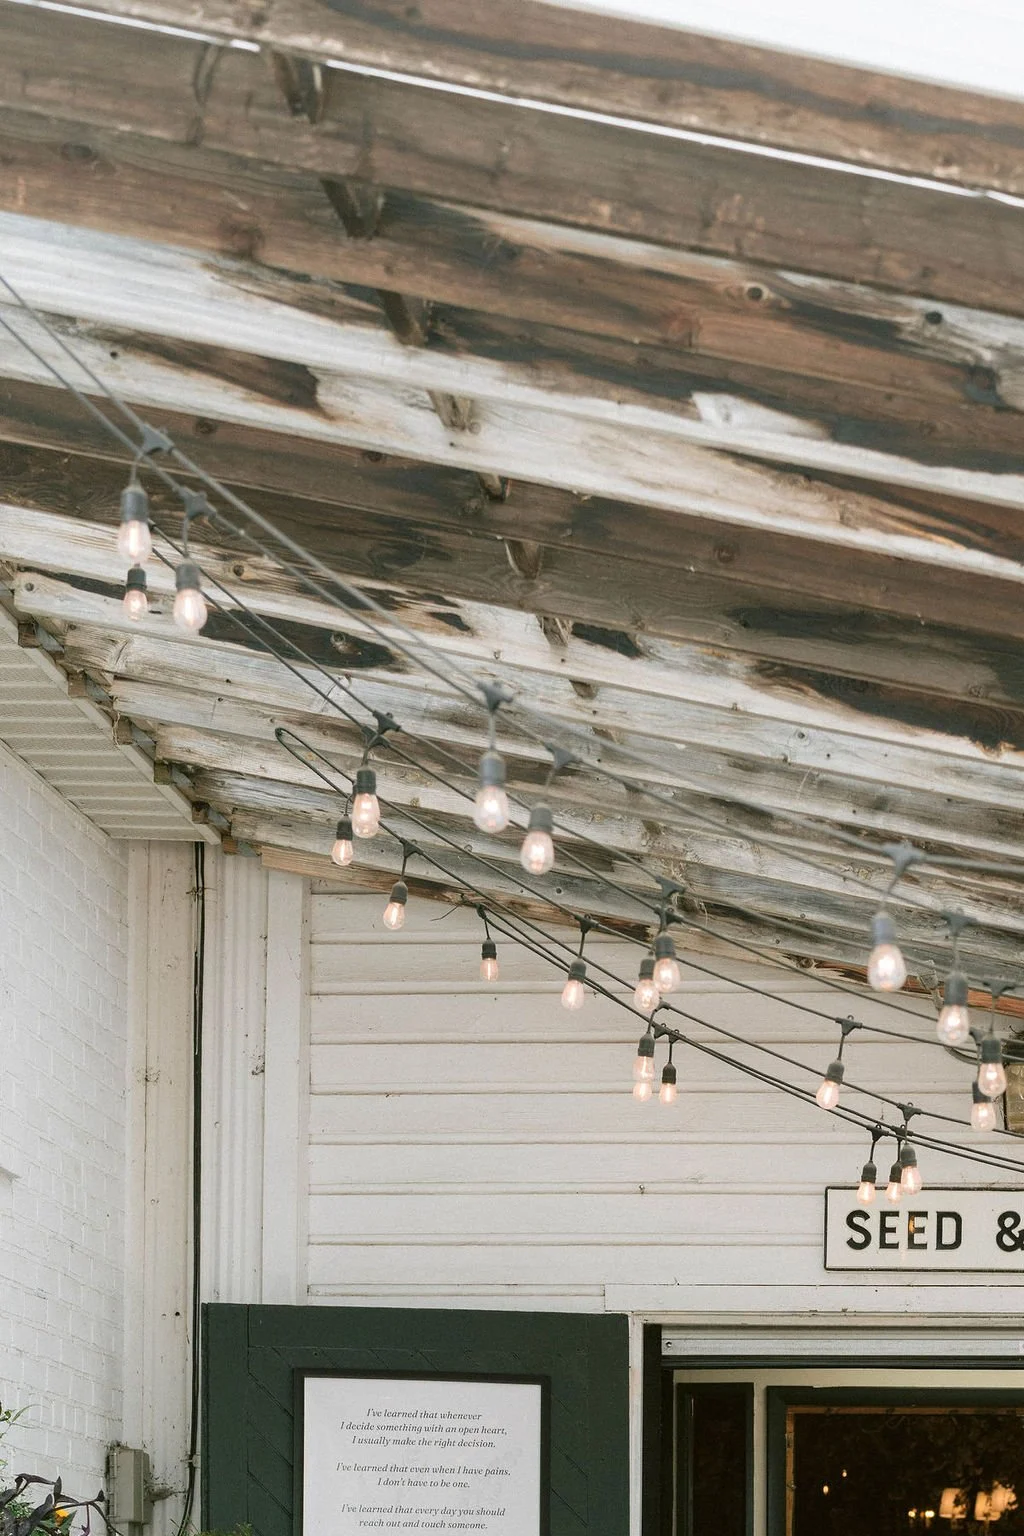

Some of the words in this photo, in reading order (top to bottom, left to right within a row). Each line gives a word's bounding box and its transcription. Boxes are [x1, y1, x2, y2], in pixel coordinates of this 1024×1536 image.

[846, 1210, 962, 1250] SEED
[366, 1408, 382, 1417] I've
[383, 1409, 419, 1418] learned
[419, 1410, 438, 1419] that
[440, 1411, 482, 1420] whenever
[340, 1421, 345, 1430] I
[345, 1422, 375, 1431] decide
[376, 1423, 423, 1434] something
[424, 1424, 444, 1433] with
[458, 1427, 479, 1435] open
[480, 1426, 508, 1435] heart,
[352, 1435, 357, 1444] I
[357, 1436, 391, 1447] usually
[392, 1437, 416, 1446] make
[418, 1437, 432, 1446] the
[433, 1438, 456, 1448] right
[457, 1439, 496, 1448] decision.
[336, 1462, 352, 1472] I've
[353, 1463, 389, 1472] learned
[389, 1464, 408, 1473] that
[432, 1465, 456, 1474] when
[457, 1466, 461, 1474] I
[462, 1466, 483, 1475] have
[377, 1477, 382, 1486] I
[383, 1478, 406, 1486] don't
[407, 1478, 428, 1487] have
[440, 1479, 451, 1488] be
[341, 1504, 357, 1513] I've
[358, 1504, 394, 1514] learned
[395, 1505, 413, 1514] that
[415, 1508, 439, 1516] every
[440, 1507, 458, 1517] day
[457, 1509, 474, 1517] you
[476, 1508, 506, 1516] should
[359, 1519, 384, 1527] reach
[402, 1519, 420, 1528] and
[421, 1520, 446, 1529] touch
[447, 1522, 488, 1530] someone.
